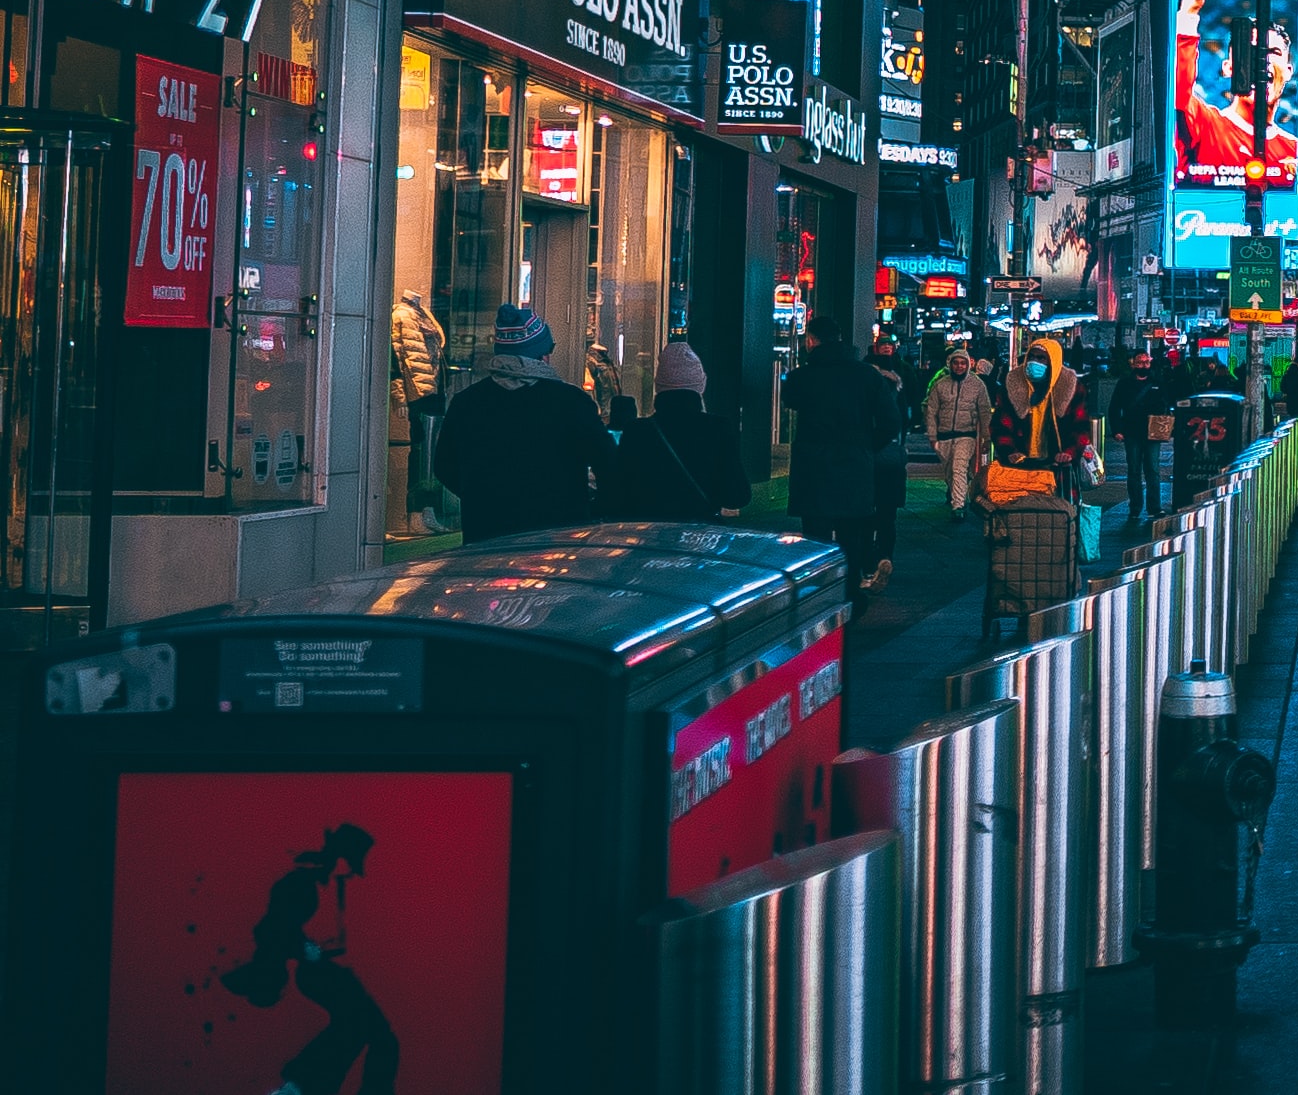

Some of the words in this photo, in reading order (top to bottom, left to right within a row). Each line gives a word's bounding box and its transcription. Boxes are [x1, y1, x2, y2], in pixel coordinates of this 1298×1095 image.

[566, 19, 600, 53] SINCE
[602, 41, 626, 67] 1890
[729, 44, 772, 64] U.S.
[727, 65, 793, 85] POLO
[157, 75, 197, 123] SALE
[725, 86, 798, 107] ASSN.
[725, 110, 756, 118] SINCE
[759, 110, 784, 118] 1890
[846, 100, 866, 165] hut
[1189, 165, 1216, 176] UEFA
[184, 236, 207, 272] OFF
[1241, 277, 1271, 288] South
